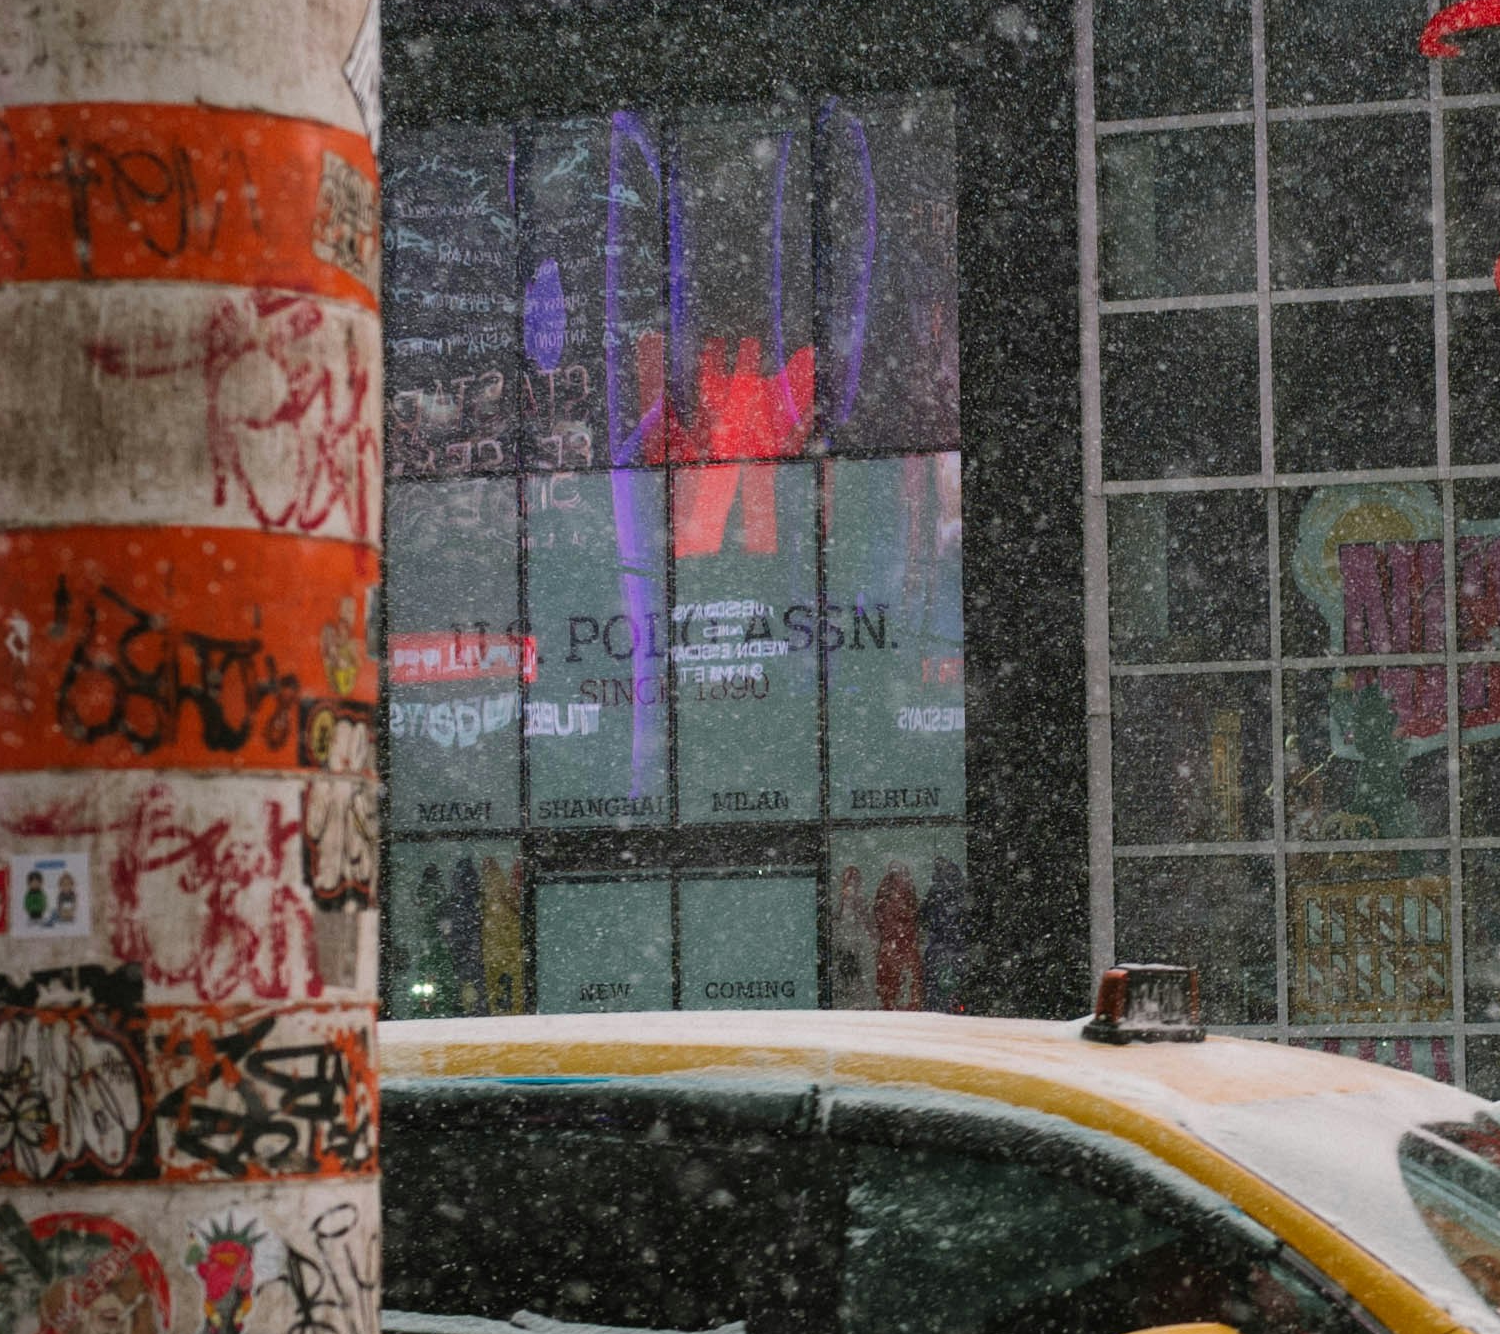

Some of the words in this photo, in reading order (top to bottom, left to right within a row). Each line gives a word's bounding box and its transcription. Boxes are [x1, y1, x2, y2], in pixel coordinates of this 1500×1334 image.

[417, 801, 492, 823] MIAMI
[538, 796, 669, 819] SHANGHAI
[711, 790, 789, 814] MILAN
[850, 787, 941, 811] BERLIN
[579, 983, 632, 1002] NEW
[704, 979, 796, 1000] COMING
